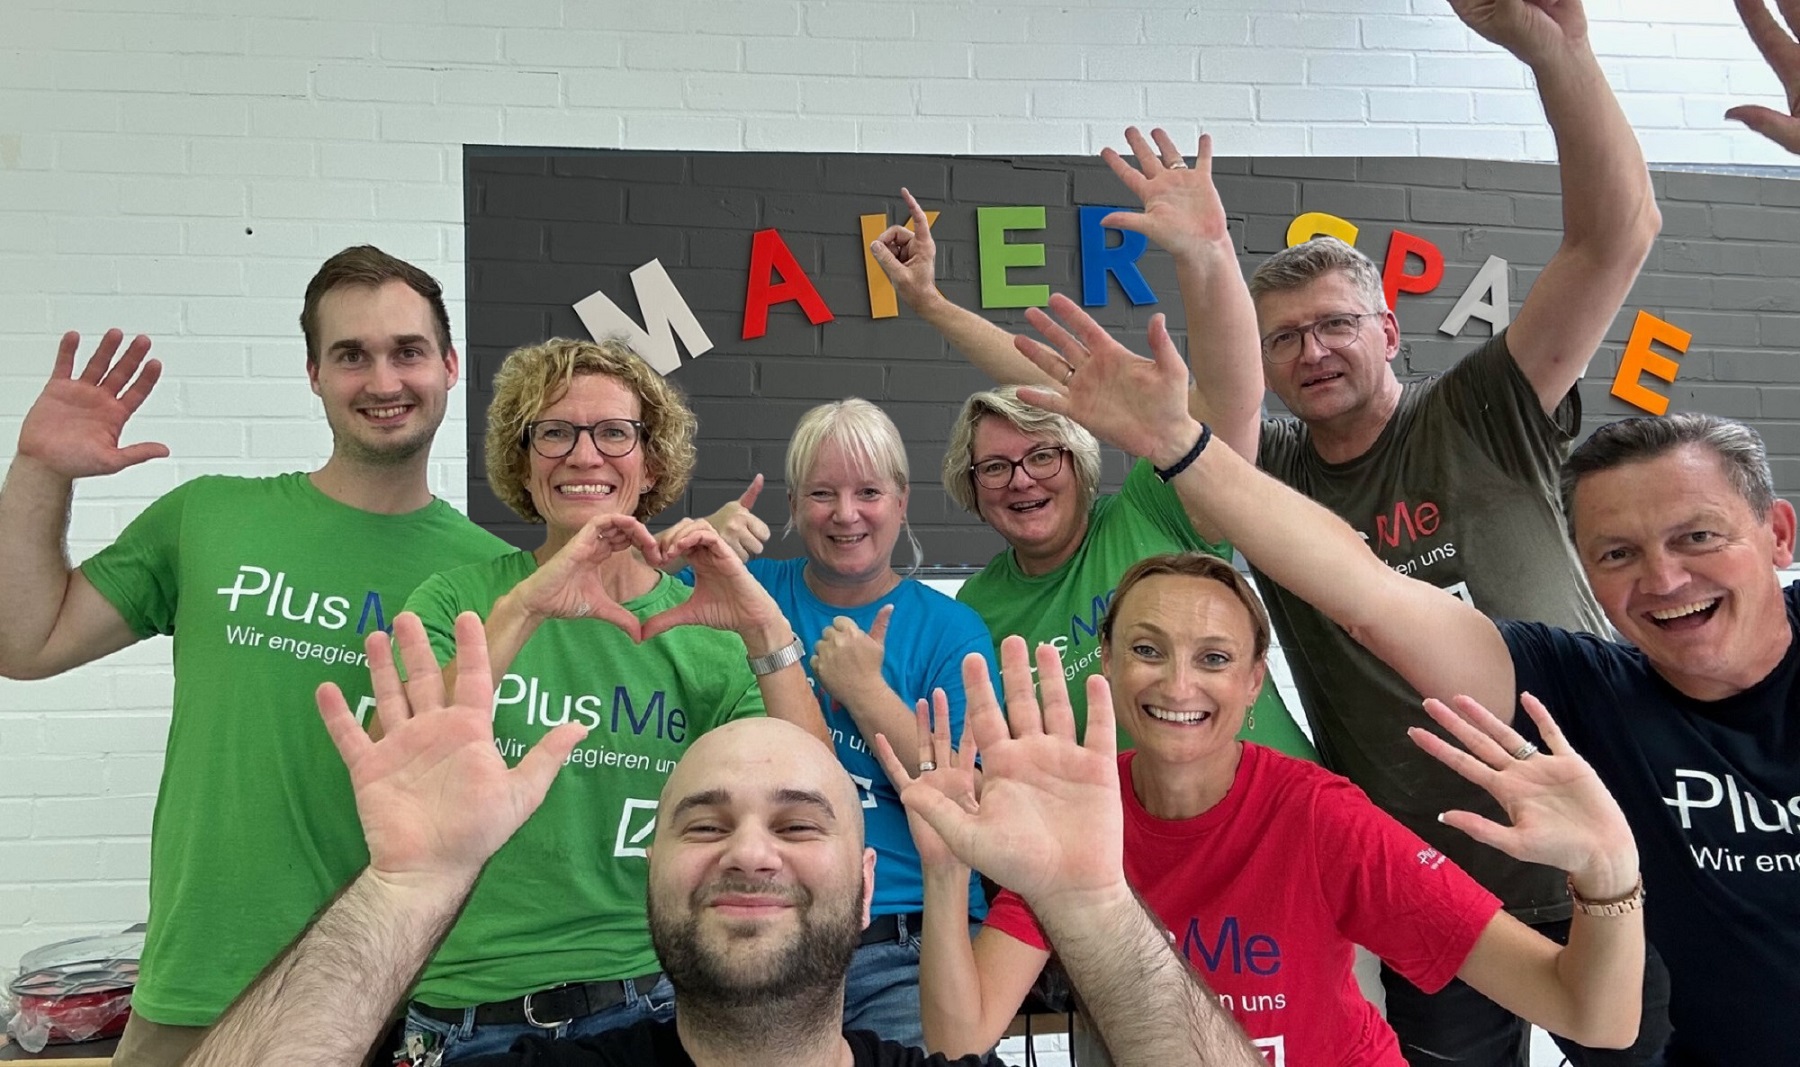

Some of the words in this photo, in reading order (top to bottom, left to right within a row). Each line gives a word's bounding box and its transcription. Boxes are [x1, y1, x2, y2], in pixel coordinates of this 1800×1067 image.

[1376, 501, 1440, 548] Me
[1420, 542, 1457, 567] uns
[217, 565, 350, 630] Plus
[226, 624, 264, 647] Wir
[268, 633, 371, 669] engagier
[492, 673, 602, 731] Plus
[611, 685, 687, 744] Me
[655, 758, 678, 774] un
[1689, 844, 1745, 872] Wir
[1182, 916, 1282, 976] Me
[1241, 993, 1286, 1012] uns
